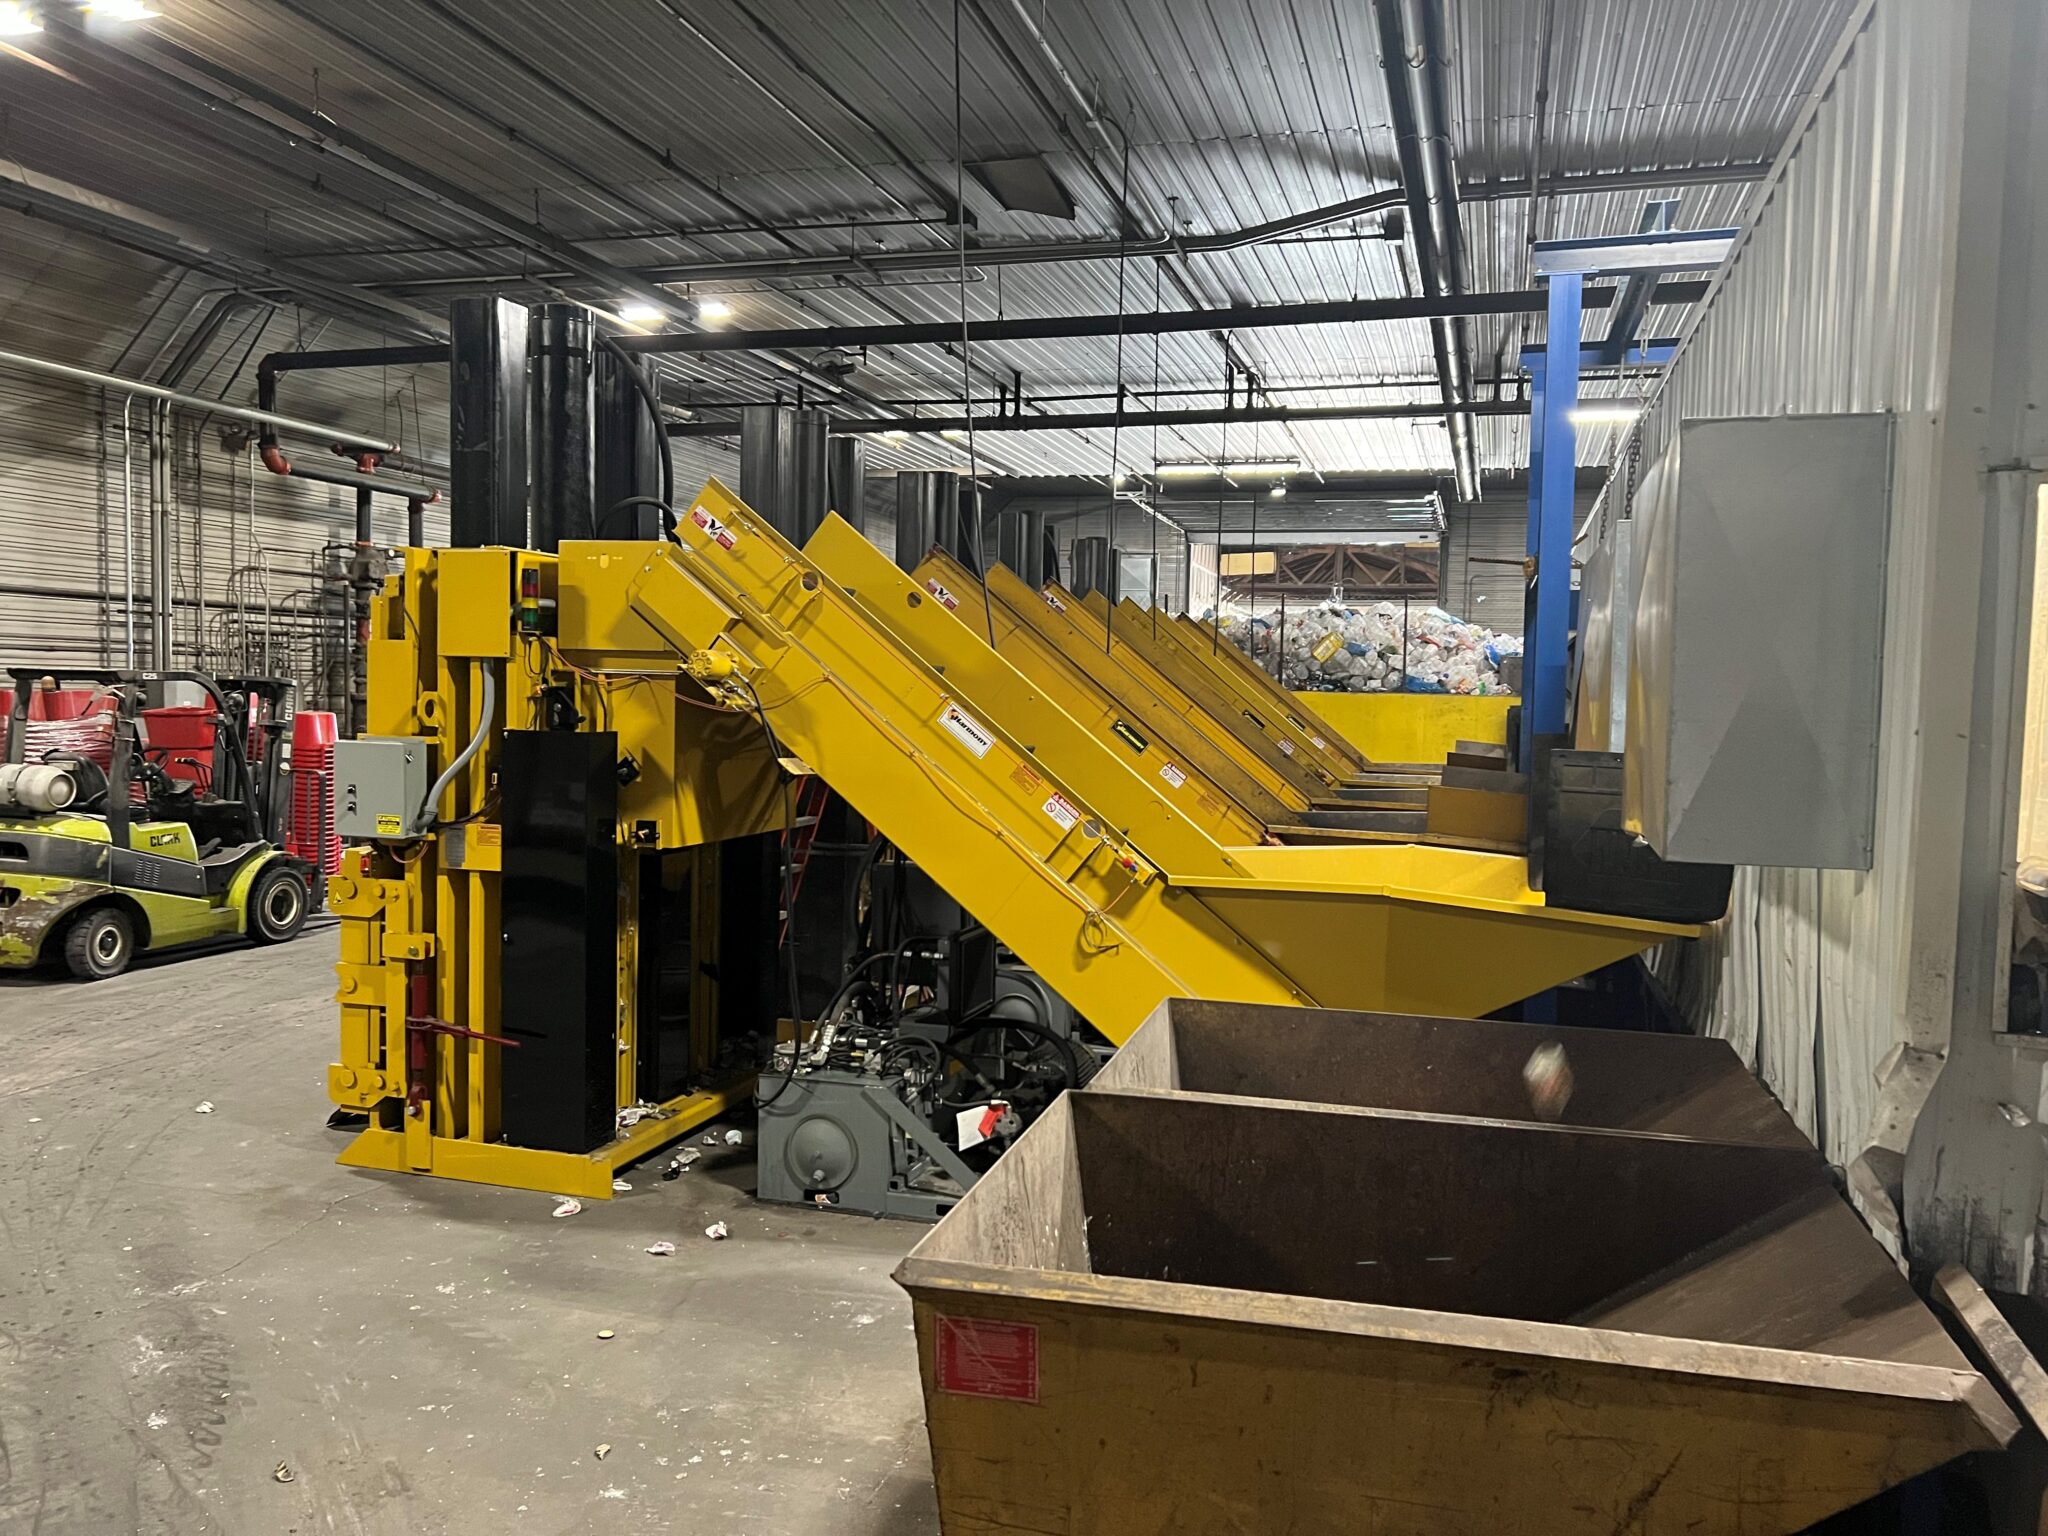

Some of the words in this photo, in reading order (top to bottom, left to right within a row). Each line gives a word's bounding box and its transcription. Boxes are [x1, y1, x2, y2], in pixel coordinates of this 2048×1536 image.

[284, 686, 294, 721] CLARK
[949, 713, 987, 746] Harmony
[1058, 797, 1080, 819] DANGER
